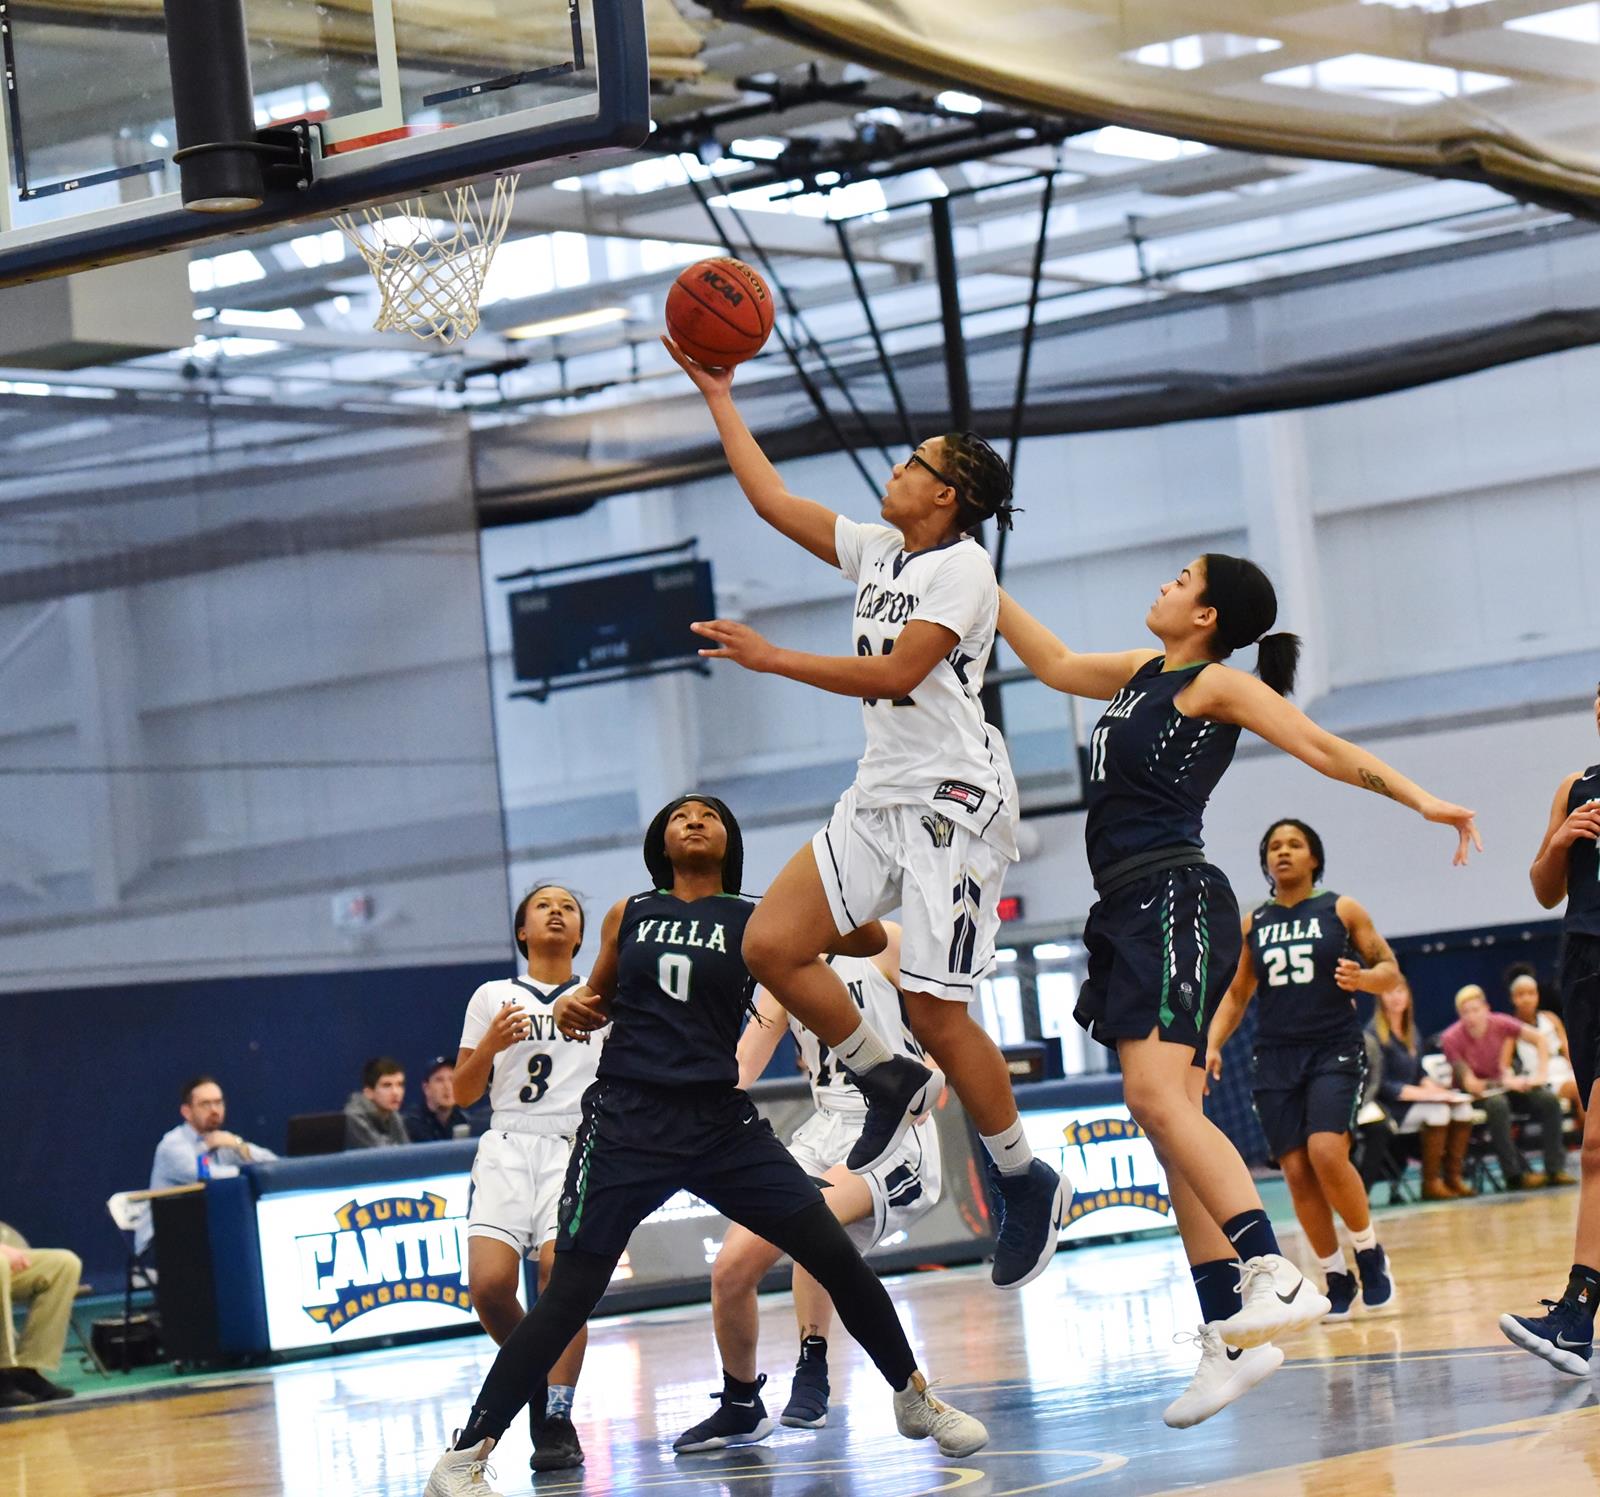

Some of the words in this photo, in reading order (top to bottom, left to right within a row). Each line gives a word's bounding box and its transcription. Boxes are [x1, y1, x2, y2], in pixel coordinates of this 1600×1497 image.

[704, 271, 743, 307] NCAA
[1105, 687, 1148, 719] LLA
[1090, 726, 1111, 782] 11
[636, 919, 727, 954] VILLA
[1257, 917, 1323, 947] VILLA
[658, 953, 692, 1003] 0
[1262, 944, 1315, 987] 25
[519, 1053, 553, 1104] 3
[354, 1200, 430, 1228] SUNY
[329, 1282, 471, 1328] KANGAROOS
